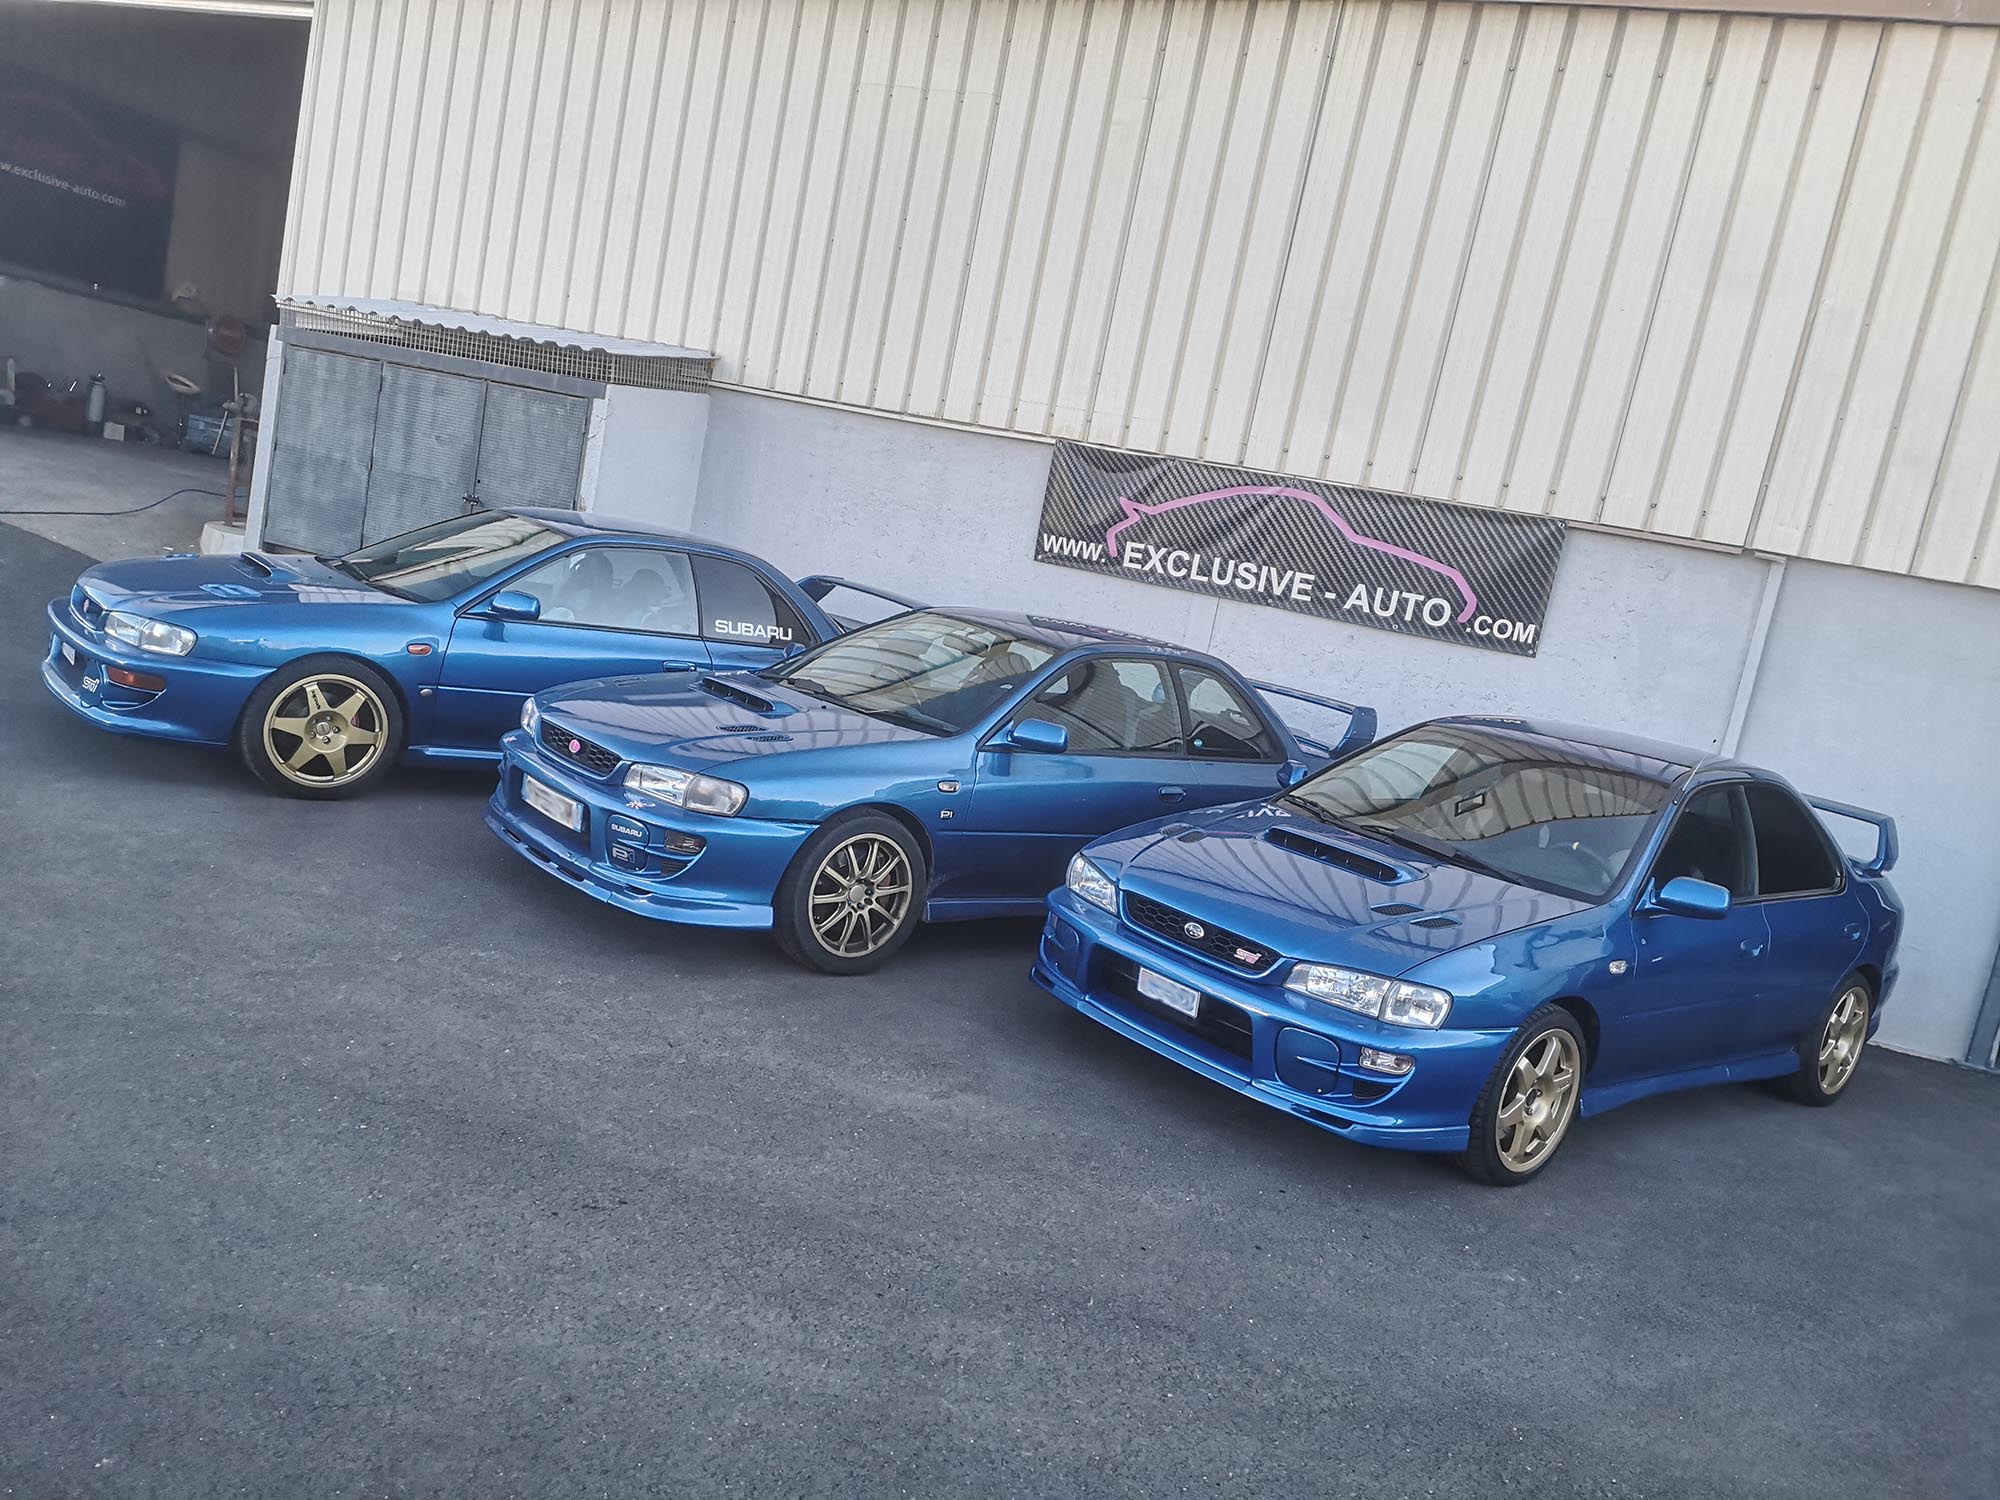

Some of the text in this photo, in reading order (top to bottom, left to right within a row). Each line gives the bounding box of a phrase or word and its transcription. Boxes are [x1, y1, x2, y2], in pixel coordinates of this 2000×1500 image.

[1122, 541, 1316, 602] EXCLUSIVE
[1324, 591, 1337, 600] -
[1343, 583, 1451, 627] AUTO
[1465, 615, 1536, 644] .COM
[715, 619, 792, 640] SUBARU
[611, 823, 643, 837] SUBARU
